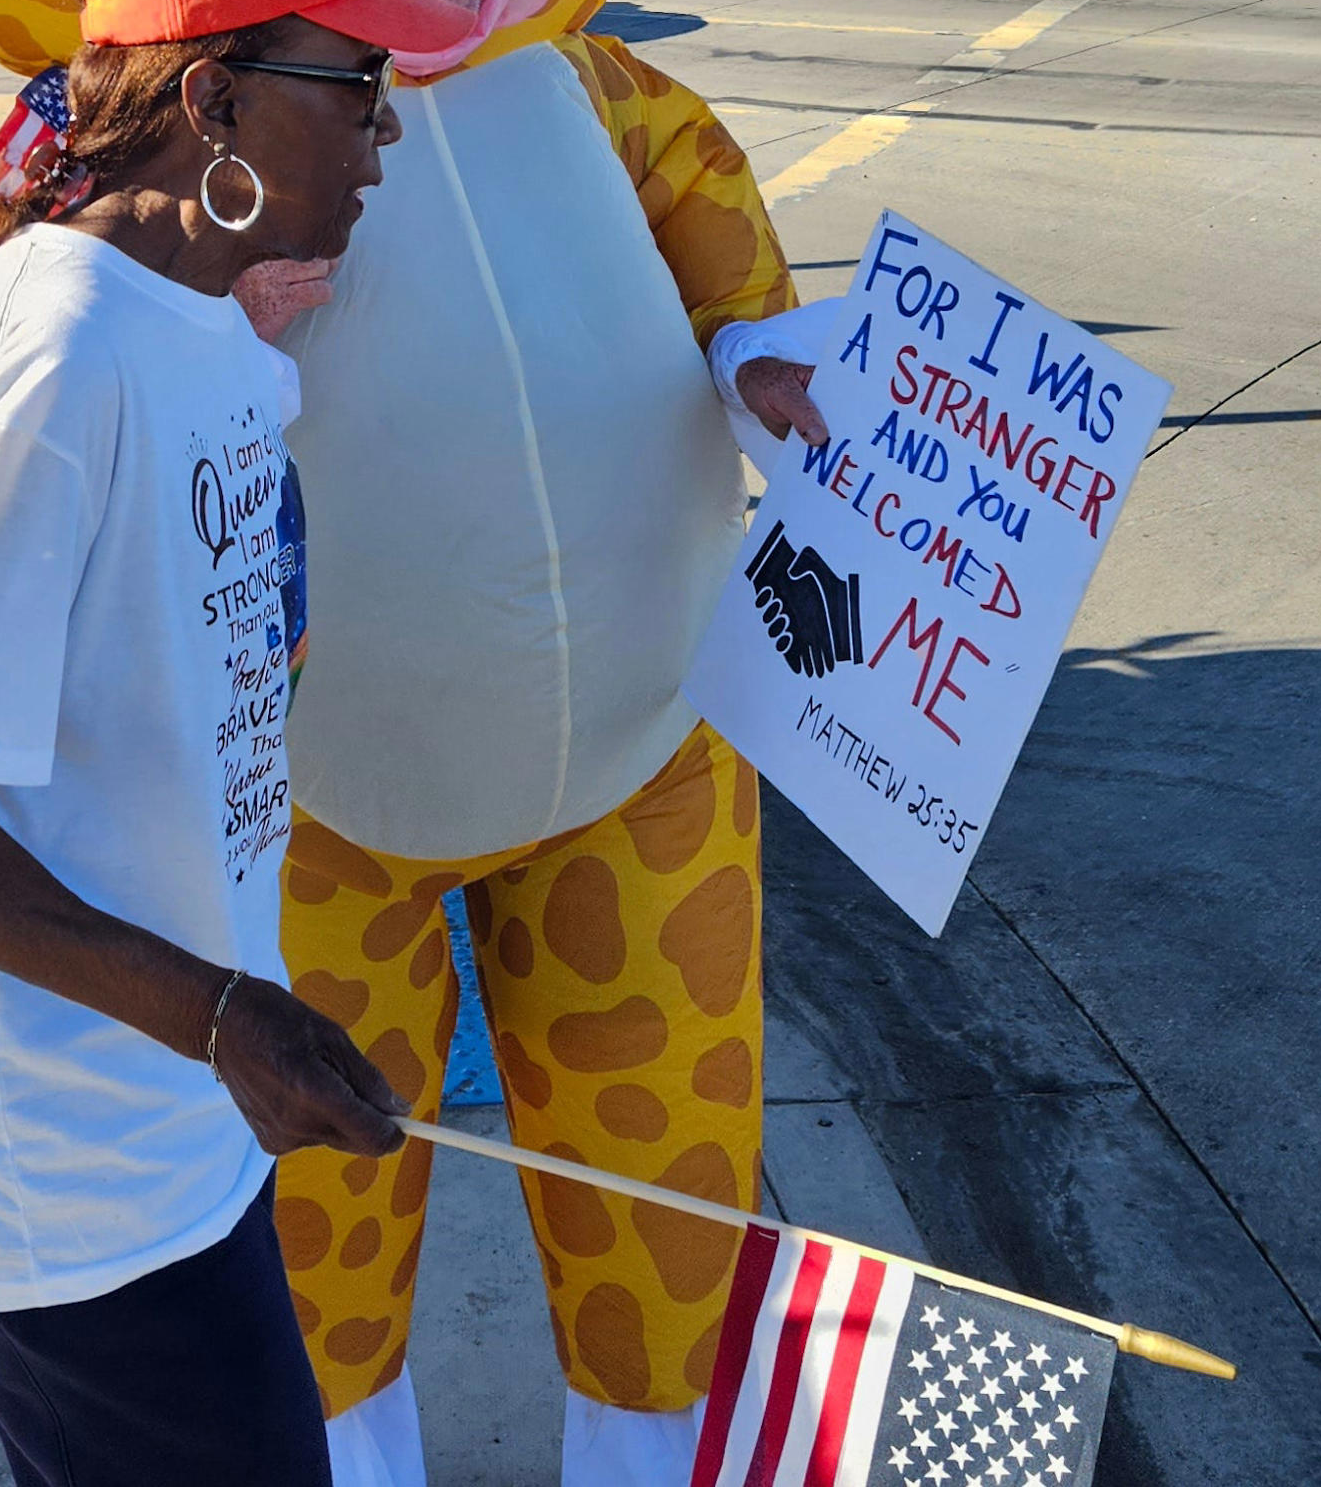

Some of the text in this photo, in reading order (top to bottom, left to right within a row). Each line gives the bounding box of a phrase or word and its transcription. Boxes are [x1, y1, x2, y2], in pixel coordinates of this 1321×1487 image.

[968, 290, 1026, 378] I
[1027, 331, 1124, 444] WAS
[222, 443, 233, 476] I
[236, 437, 264, 471] am
[838, 312, 1117, 540] A STRANGER
[870, 409, 950, 484] AND
[191, 458, 277, 571] Queen
[239, 523, 276, 565] I am
[802, 435, 1022, 620] WELCOMED
[202, 544, 297, 627] STRONGER
[796, 694, 979, 854] MATTHEW 25:35
